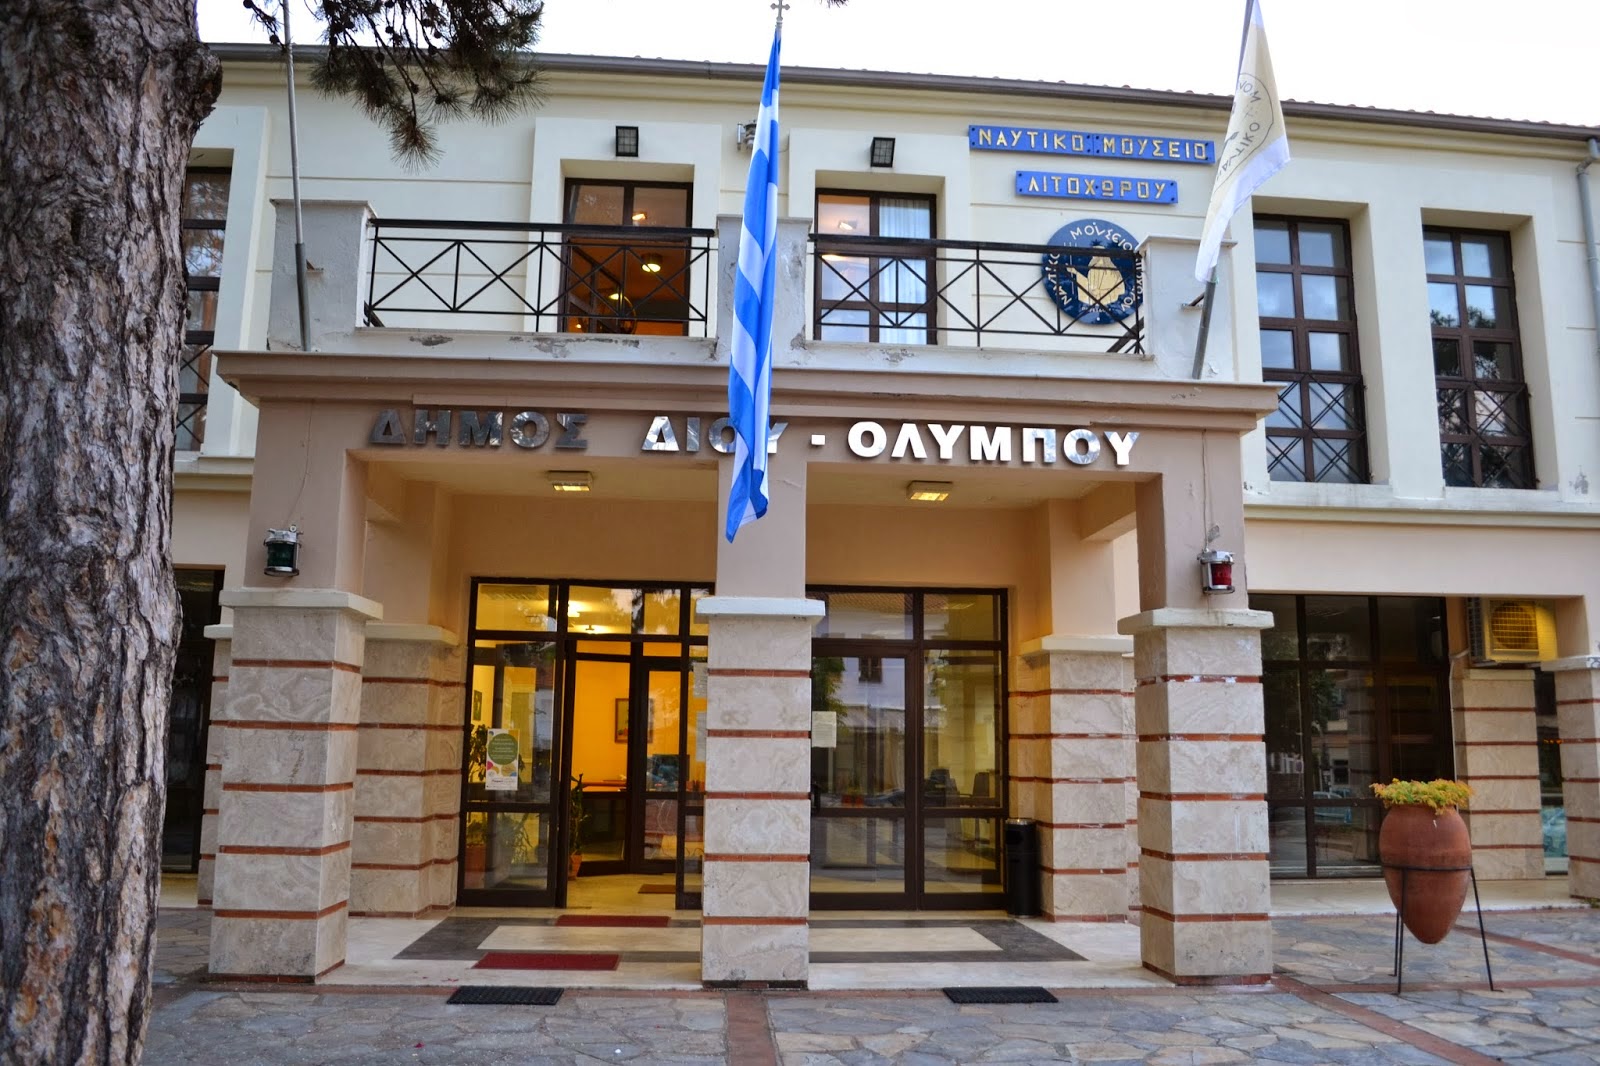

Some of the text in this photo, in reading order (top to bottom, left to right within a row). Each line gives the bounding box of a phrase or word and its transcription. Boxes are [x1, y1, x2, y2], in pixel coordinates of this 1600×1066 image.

[978, 128, 1207, 160] ΝΑΥΤΙΚΟ ΜΟΥΣΕΙΟ
[1027, 176, 1166, 199] ΛΙΤΟΧΩΡΟΥ
[368, 409, 588, 450] ΔΗΜΟΣ
[847, 421, 1140, 466] ΟΛΥΜΠΟΥ
